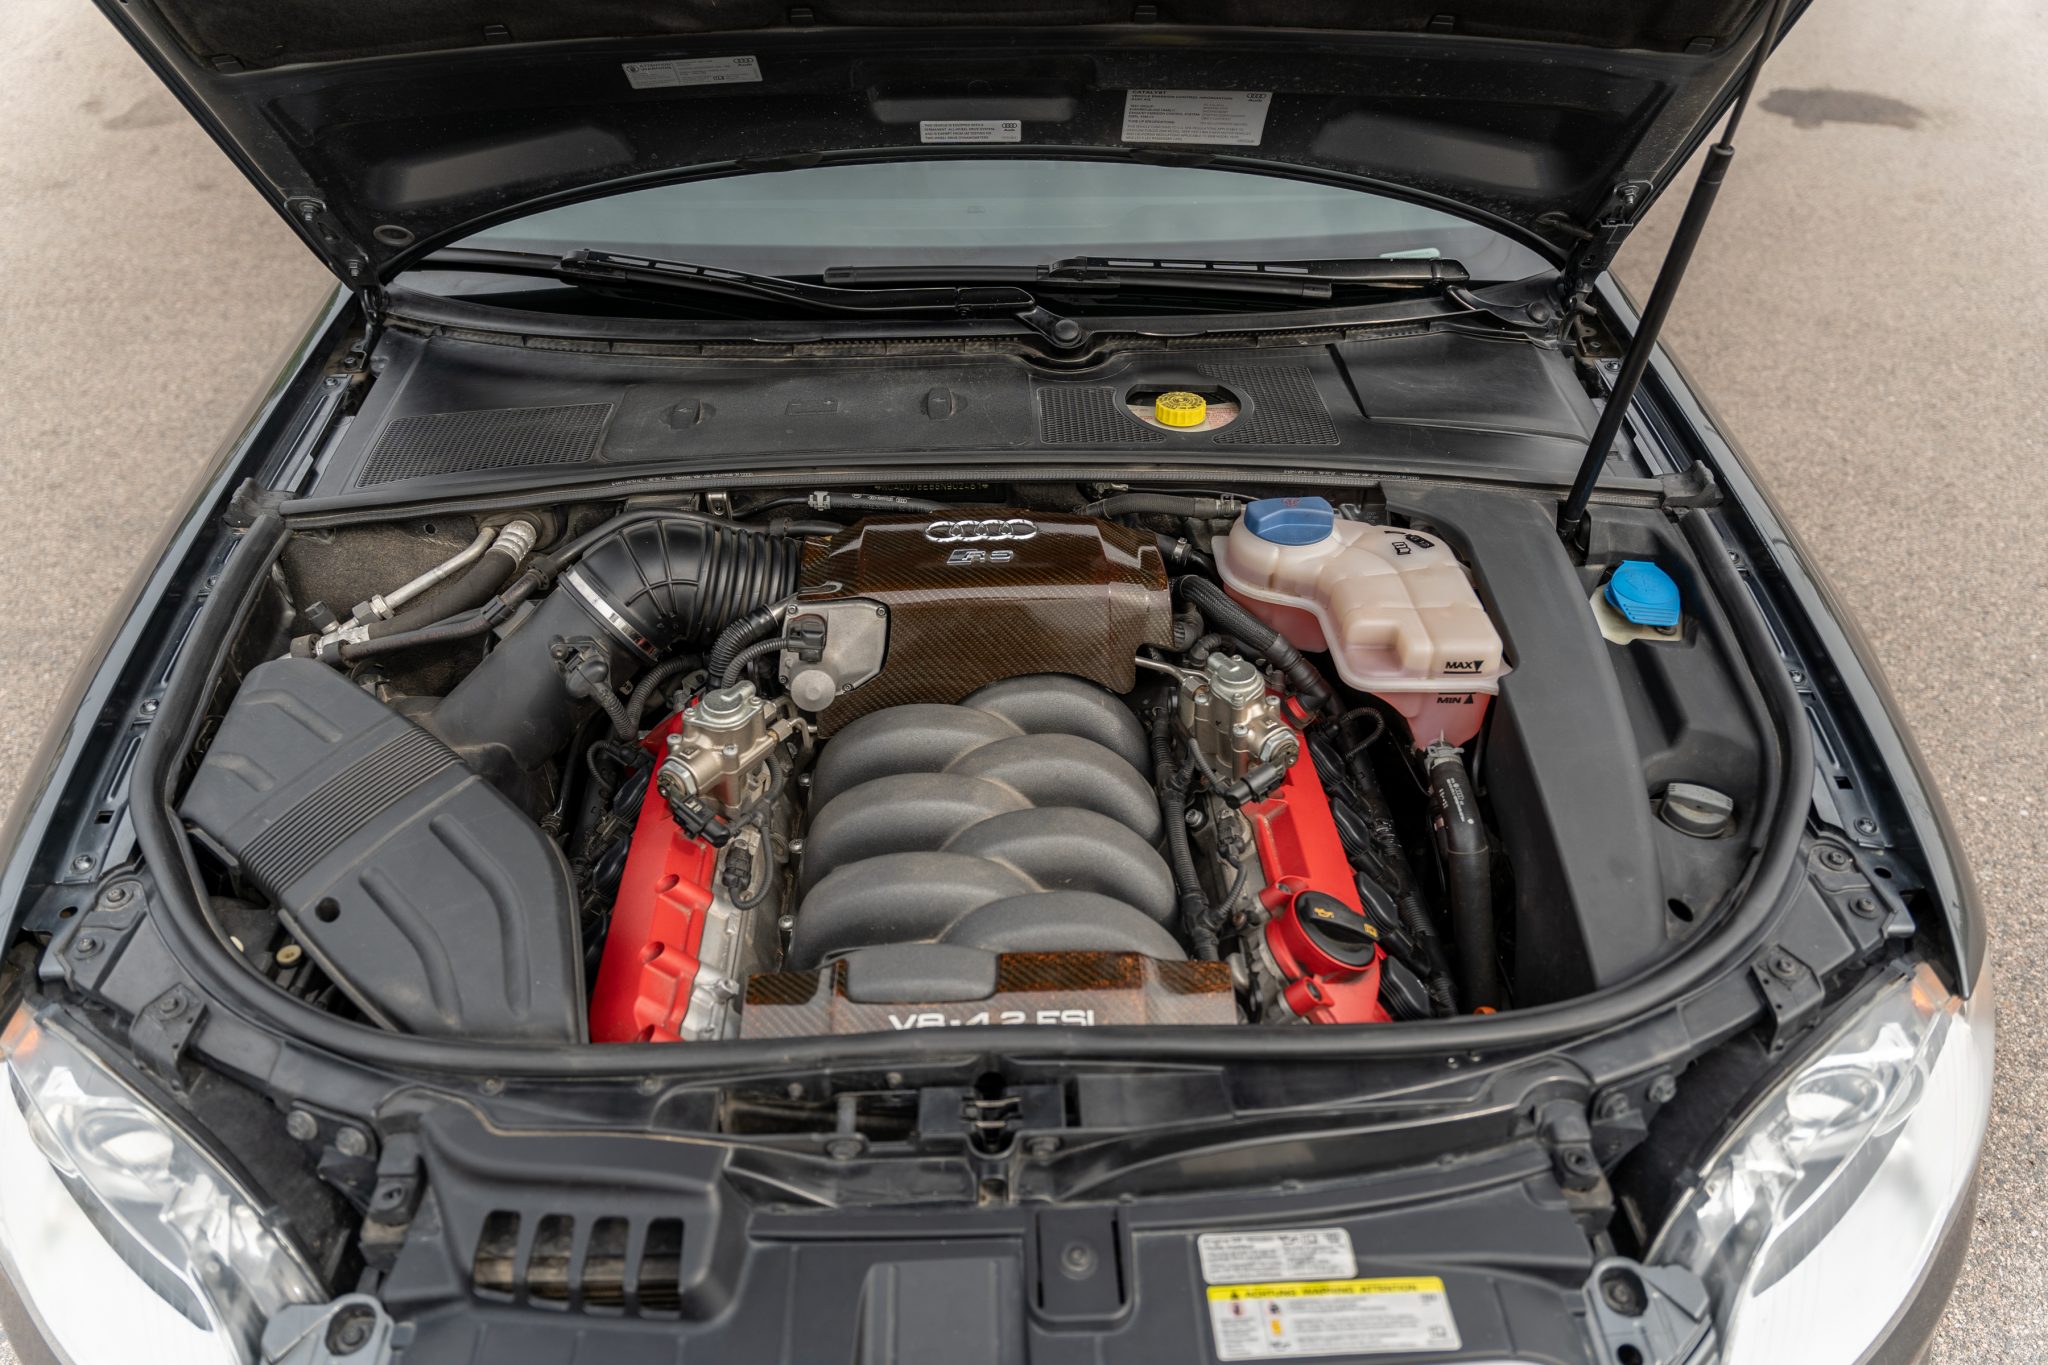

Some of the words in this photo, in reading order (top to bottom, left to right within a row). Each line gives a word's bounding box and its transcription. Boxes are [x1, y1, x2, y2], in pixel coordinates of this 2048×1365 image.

[1445, 661, 1473, 669] MAX
[1302, 1287, 1353, 1296] WARNING
[1360, 1285, 1417, 1293] ATTENTION
